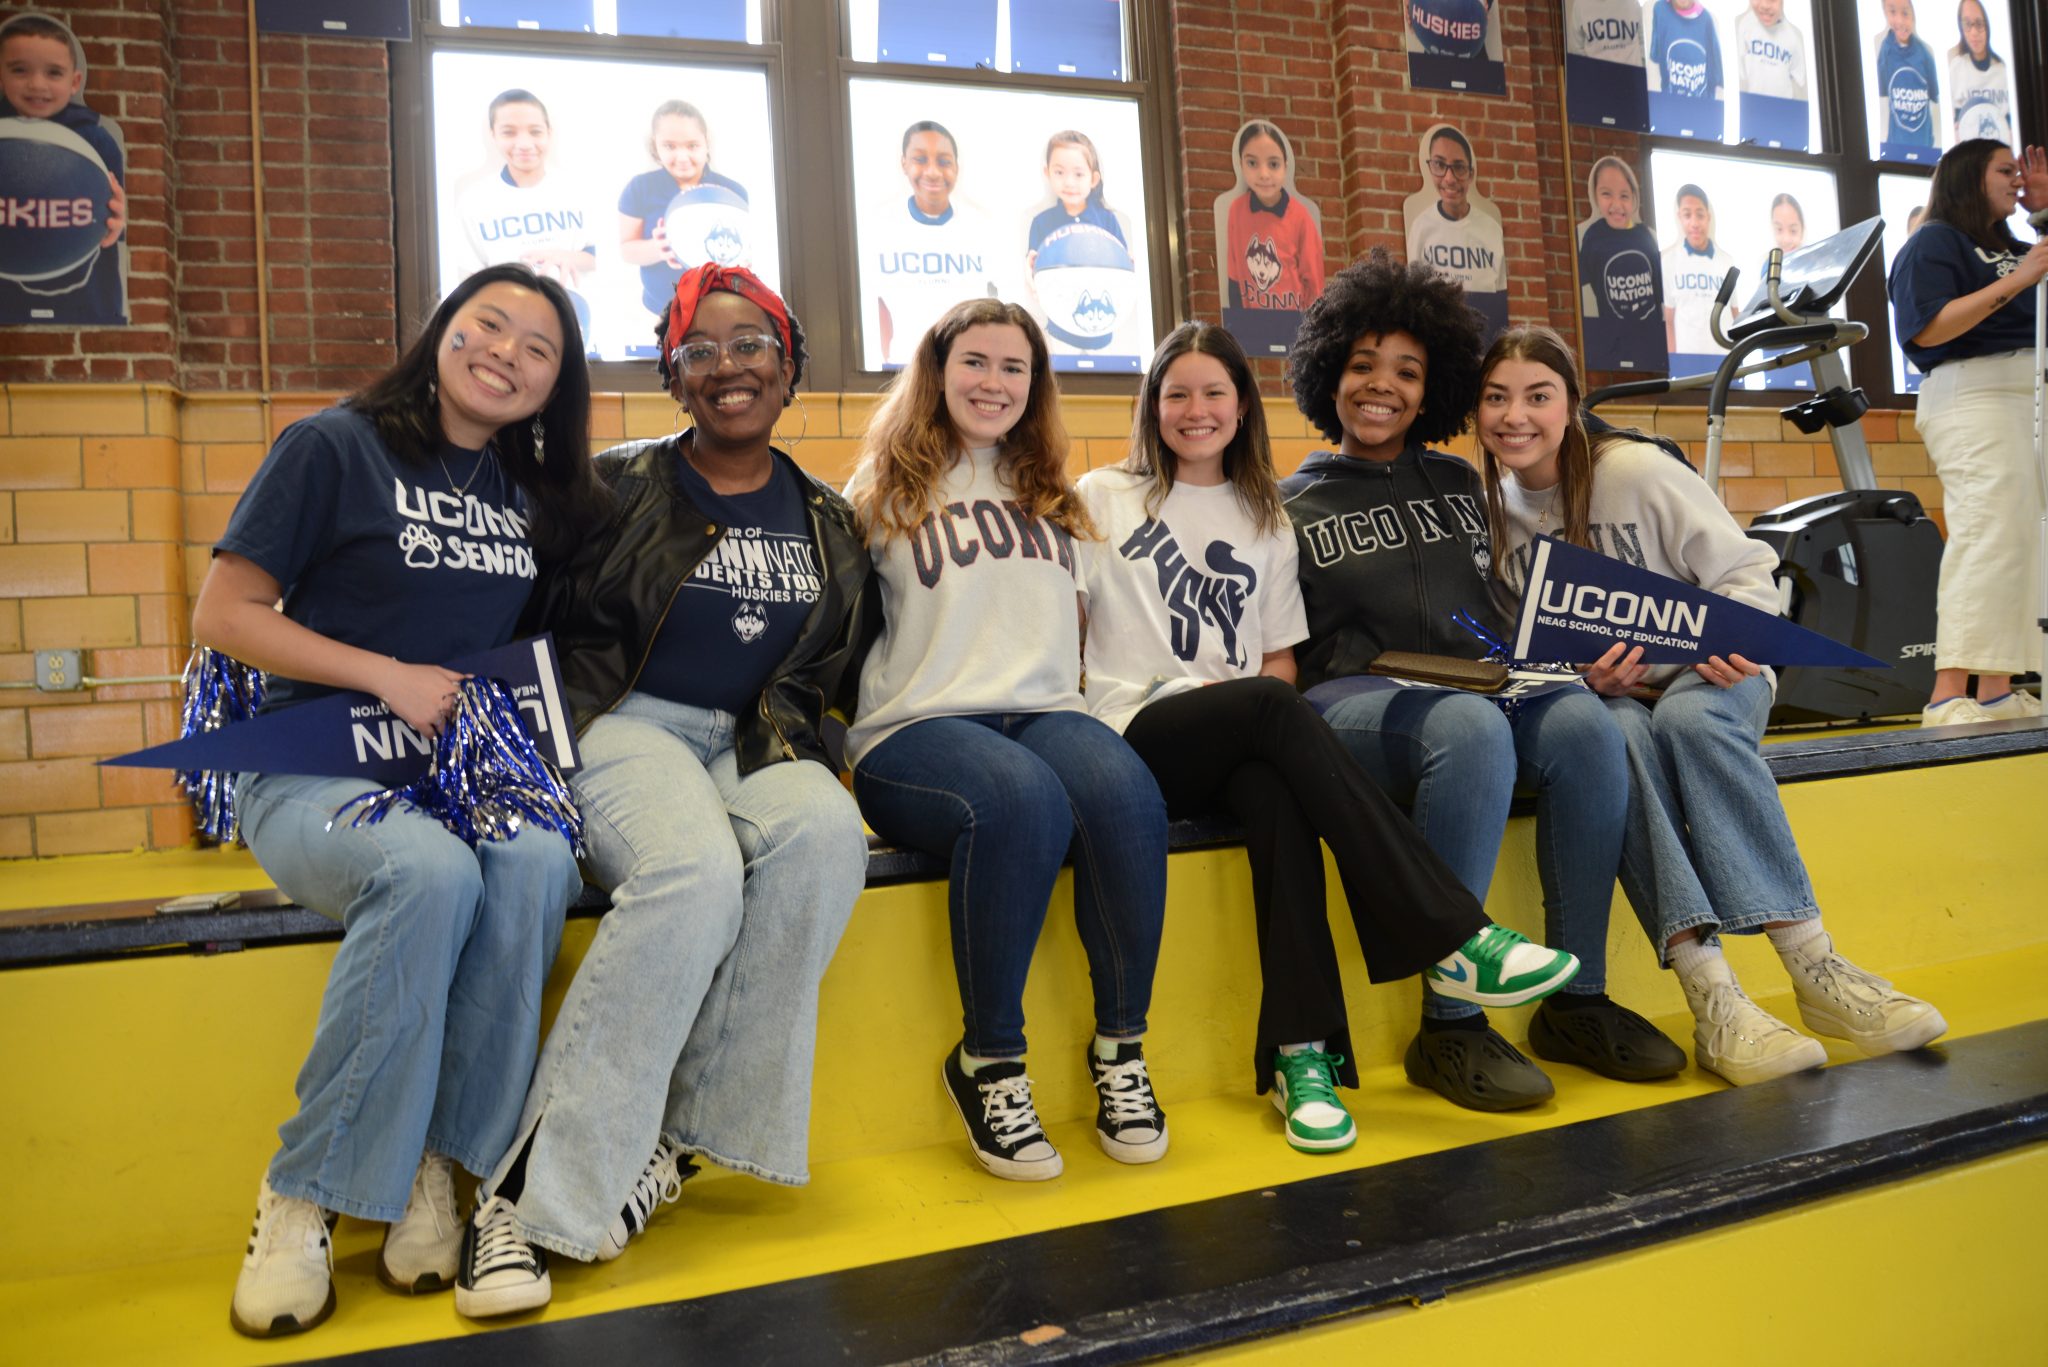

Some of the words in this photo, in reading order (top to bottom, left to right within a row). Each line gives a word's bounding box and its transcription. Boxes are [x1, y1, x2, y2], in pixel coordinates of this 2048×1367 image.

[1412, 4, 1481, 40] HUSKIES
[0, 197, 94, 228] KIES
[479, 210, 584, 241] UCONN
[879, 251, 983, 274] UCONN
[1606, 270, 1653, 290] UCONN
[1609, 284, 1654, 302] NATION
[394, 477, 533, 539] UCONN
[744, 527, 763, 538] OF
[1303, 494, 1488, 568] UCONN
[731, 585, 791, 603] HUSKIES
[1539, 579, 1709, 638] UCONN
[1536, 614, 1567, 628] NEAG
[1568, 620, 1613, 637] SCHOOL
[1615, 627, 1632, 640] OF
[1632, 630, 1699, 651] EDUCATION
[350, 700, 391, 719] ATION
